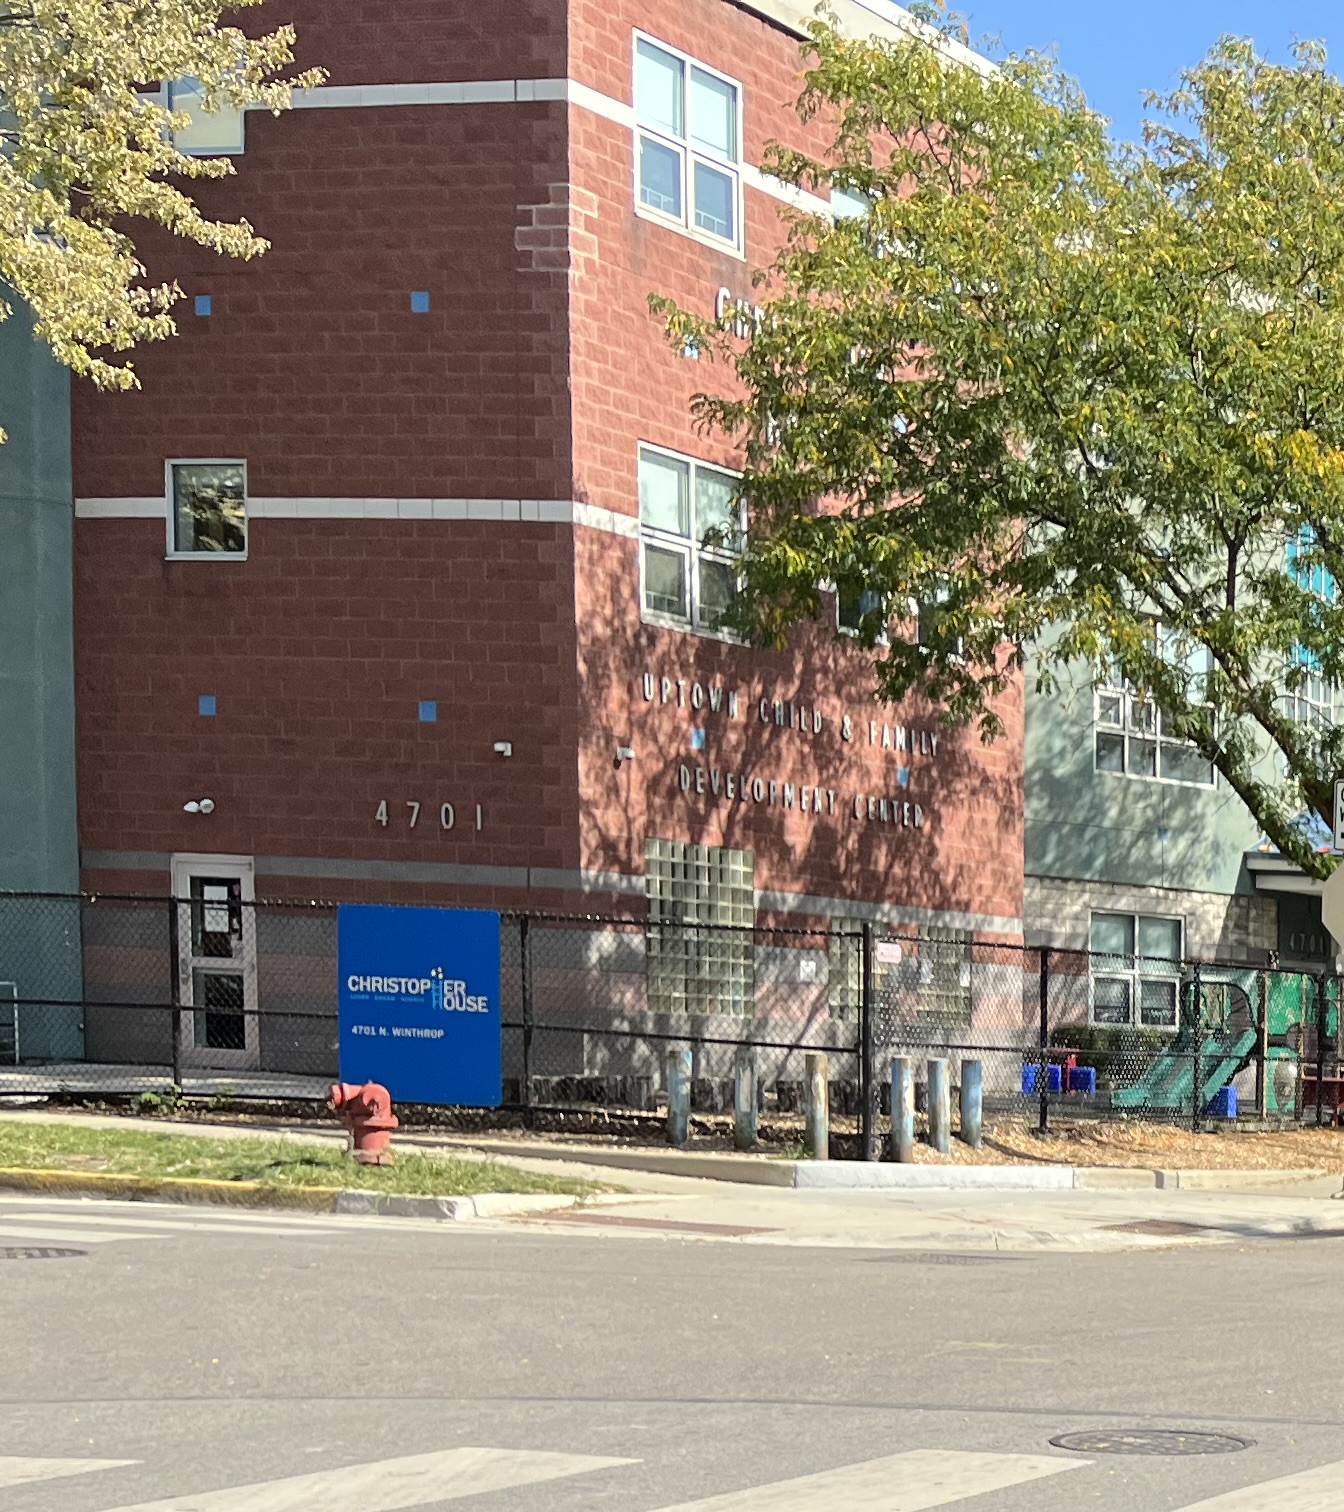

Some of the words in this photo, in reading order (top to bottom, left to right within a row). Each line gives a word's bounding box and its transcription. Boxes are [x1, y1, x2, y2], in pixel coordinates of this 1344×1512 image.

[641, 672, 738, 718] UPTOWN
[759, 697, 823, 735] CHILD
[842, 714, 853, 742] &
[868, 720, 939, 757] FAMILY
[678, 763, 836, 816] DEVELOPMENT
[853, 793, 924, 829] CENTER
[375, 800, 485, 831] 4701
[1289, 932, 1326, 954] 4701
[347, 974, 467, 997] CHRISTOPHER
[351, 1025, 376, 1036] 4701
[392, 1026, 445, 1040] WINTHROP
